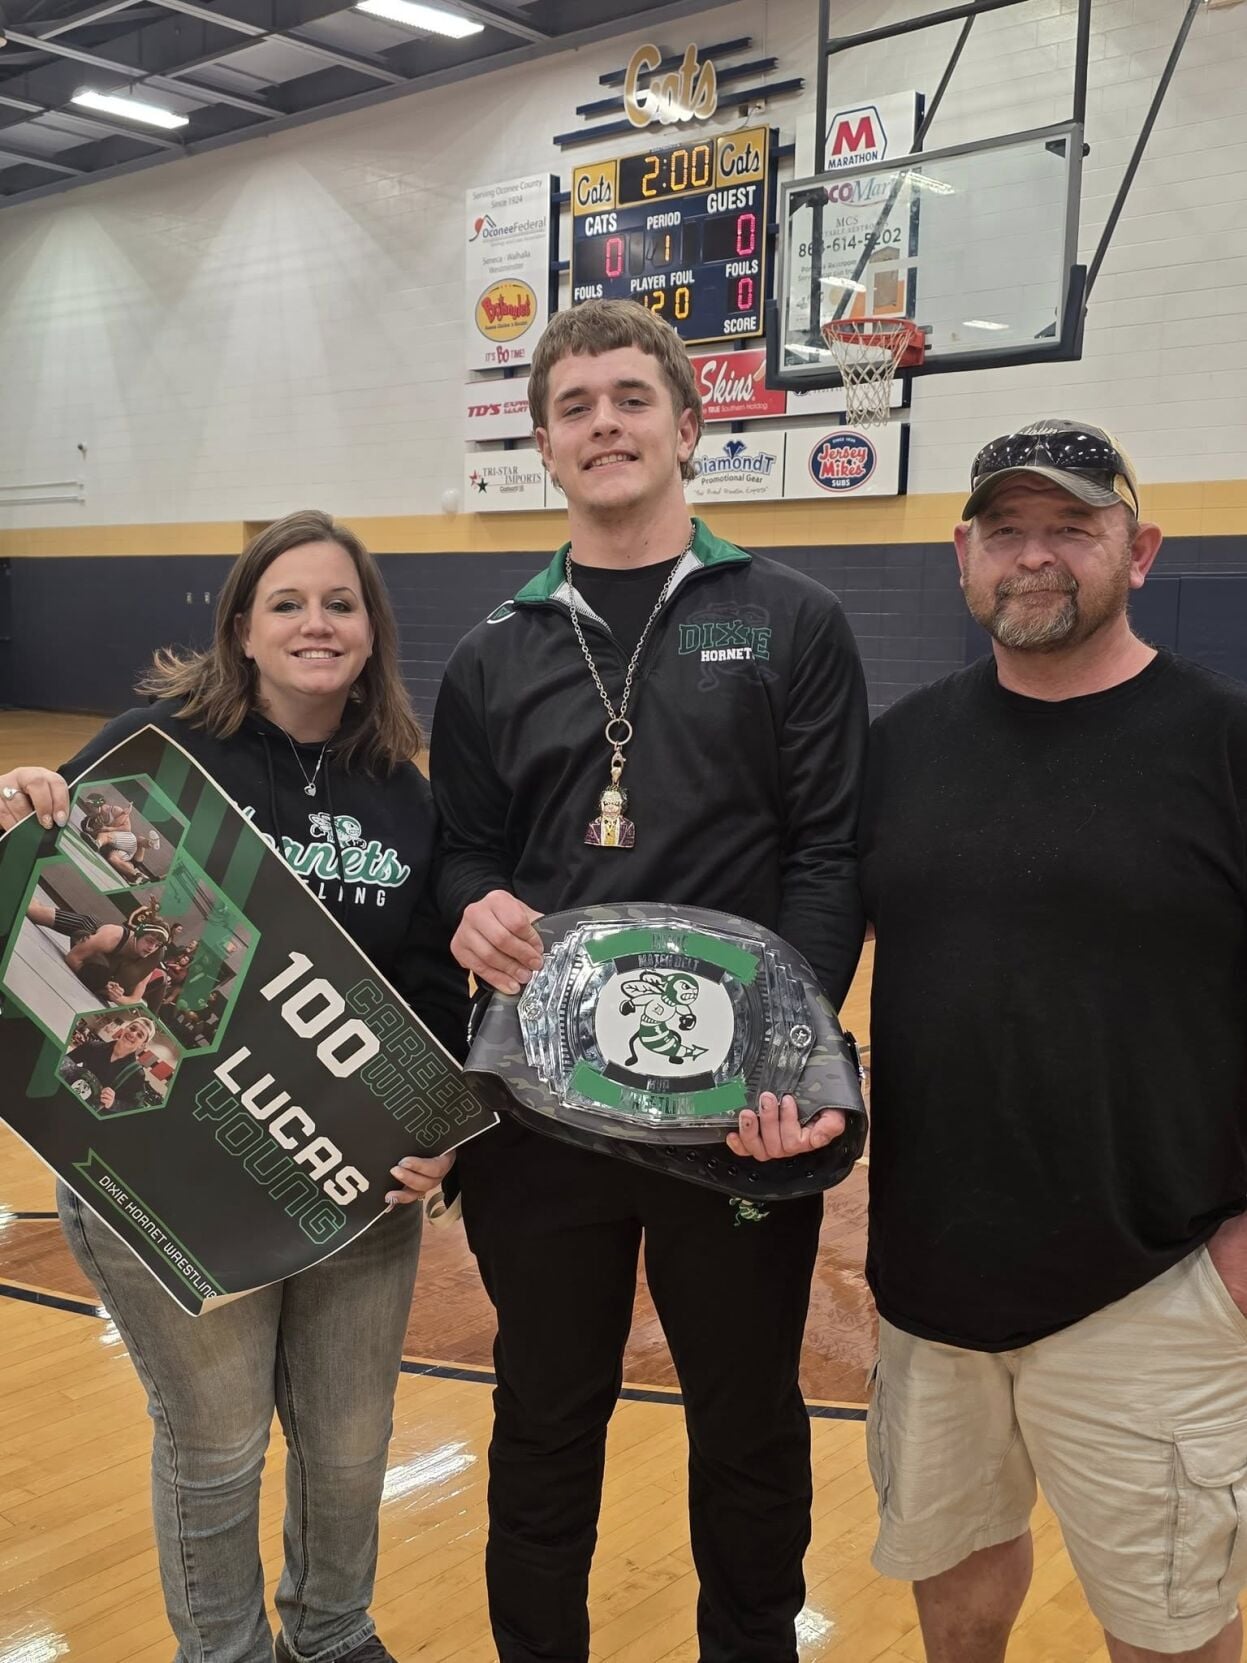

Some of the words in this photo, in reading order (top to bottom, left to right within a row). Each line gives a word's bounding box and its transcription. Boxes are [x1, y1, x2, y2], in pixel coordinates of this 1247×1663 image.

[624, 43, 717, 128] Cats
[832, 116, 876, 156] M
[642, 144, 710, 198] 2:00
[720, 143, 760, 176] Cats
[827, 151, 878, 169] MARATHON
[577, 175, 612, 206] Cats
[707, 185, 756, 214] GUEST
[482, 216, 546, 238] OconeeFederal
[585, 212, 618, 236] CATS
[646, 211, 682, 230] PERIOD
[736, 213, 756, 256] 0
[664, 234, 671, 262] 1
[798, 227, 902, 258] 86-614-502
[605, 236, 624, 278] 0
[725, 259, 759, 278] FOULS
[574, 284, 603, 300] FOULS
[630, 274, 666, 292] PLAYER
[670, 270, 695, 286] FOUL
[737, 277, 753, 310] 0
[723, 316, 757, 334] SCORE
[496, 345, 510, 364] BO
[817, 443, 868, 463] Jersey
[483, 466, 518, 477] TRI-STAR
[505, 472, 542, 485] IMPORTS
[701, 474, 745, 485] Promotional
[746, 474, 763, 483] Gear
[832, 479, 850, 487] SUBS
[701, 647, 752, 662] HORNET
[260, 951, 380, 1078] 100
[345, 979, 481, 1126] CAREER
[360, 1053, 450, 1148] WINS
[213, 1046, 369, 1206] LUCAS
[192, 1079, 346, 1244] YOUNG
[98, 1175, 129, 1206] DIXIE
[124, 1201, 168, 1244] HORNET
[163, 1242, 217, 1299] WRESTLING
